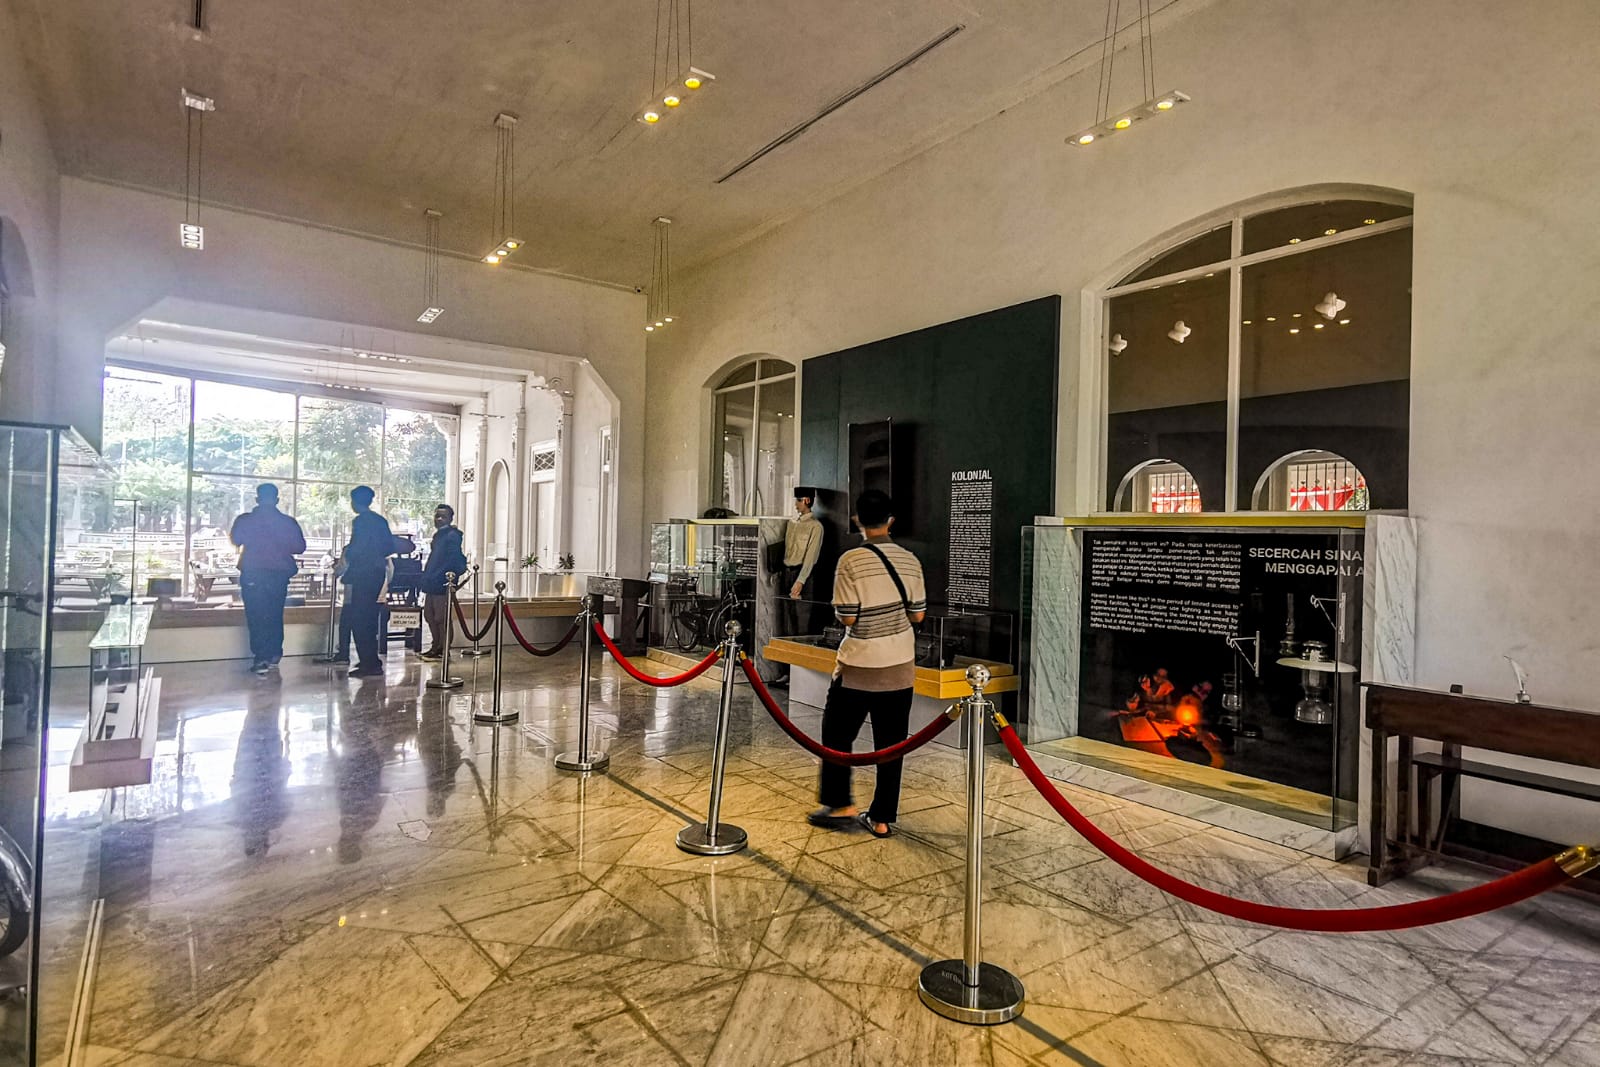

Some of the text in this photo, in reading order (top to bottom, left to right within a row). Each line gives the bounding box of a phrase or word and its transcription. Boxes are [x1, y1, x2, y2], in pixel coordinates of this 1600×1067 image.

[952, 470, 992, 481] KOLONIAL
[1249, 548, 1320, 560] SECERCAH
[1265, 562, 1351, 576] MENGGAPAI
